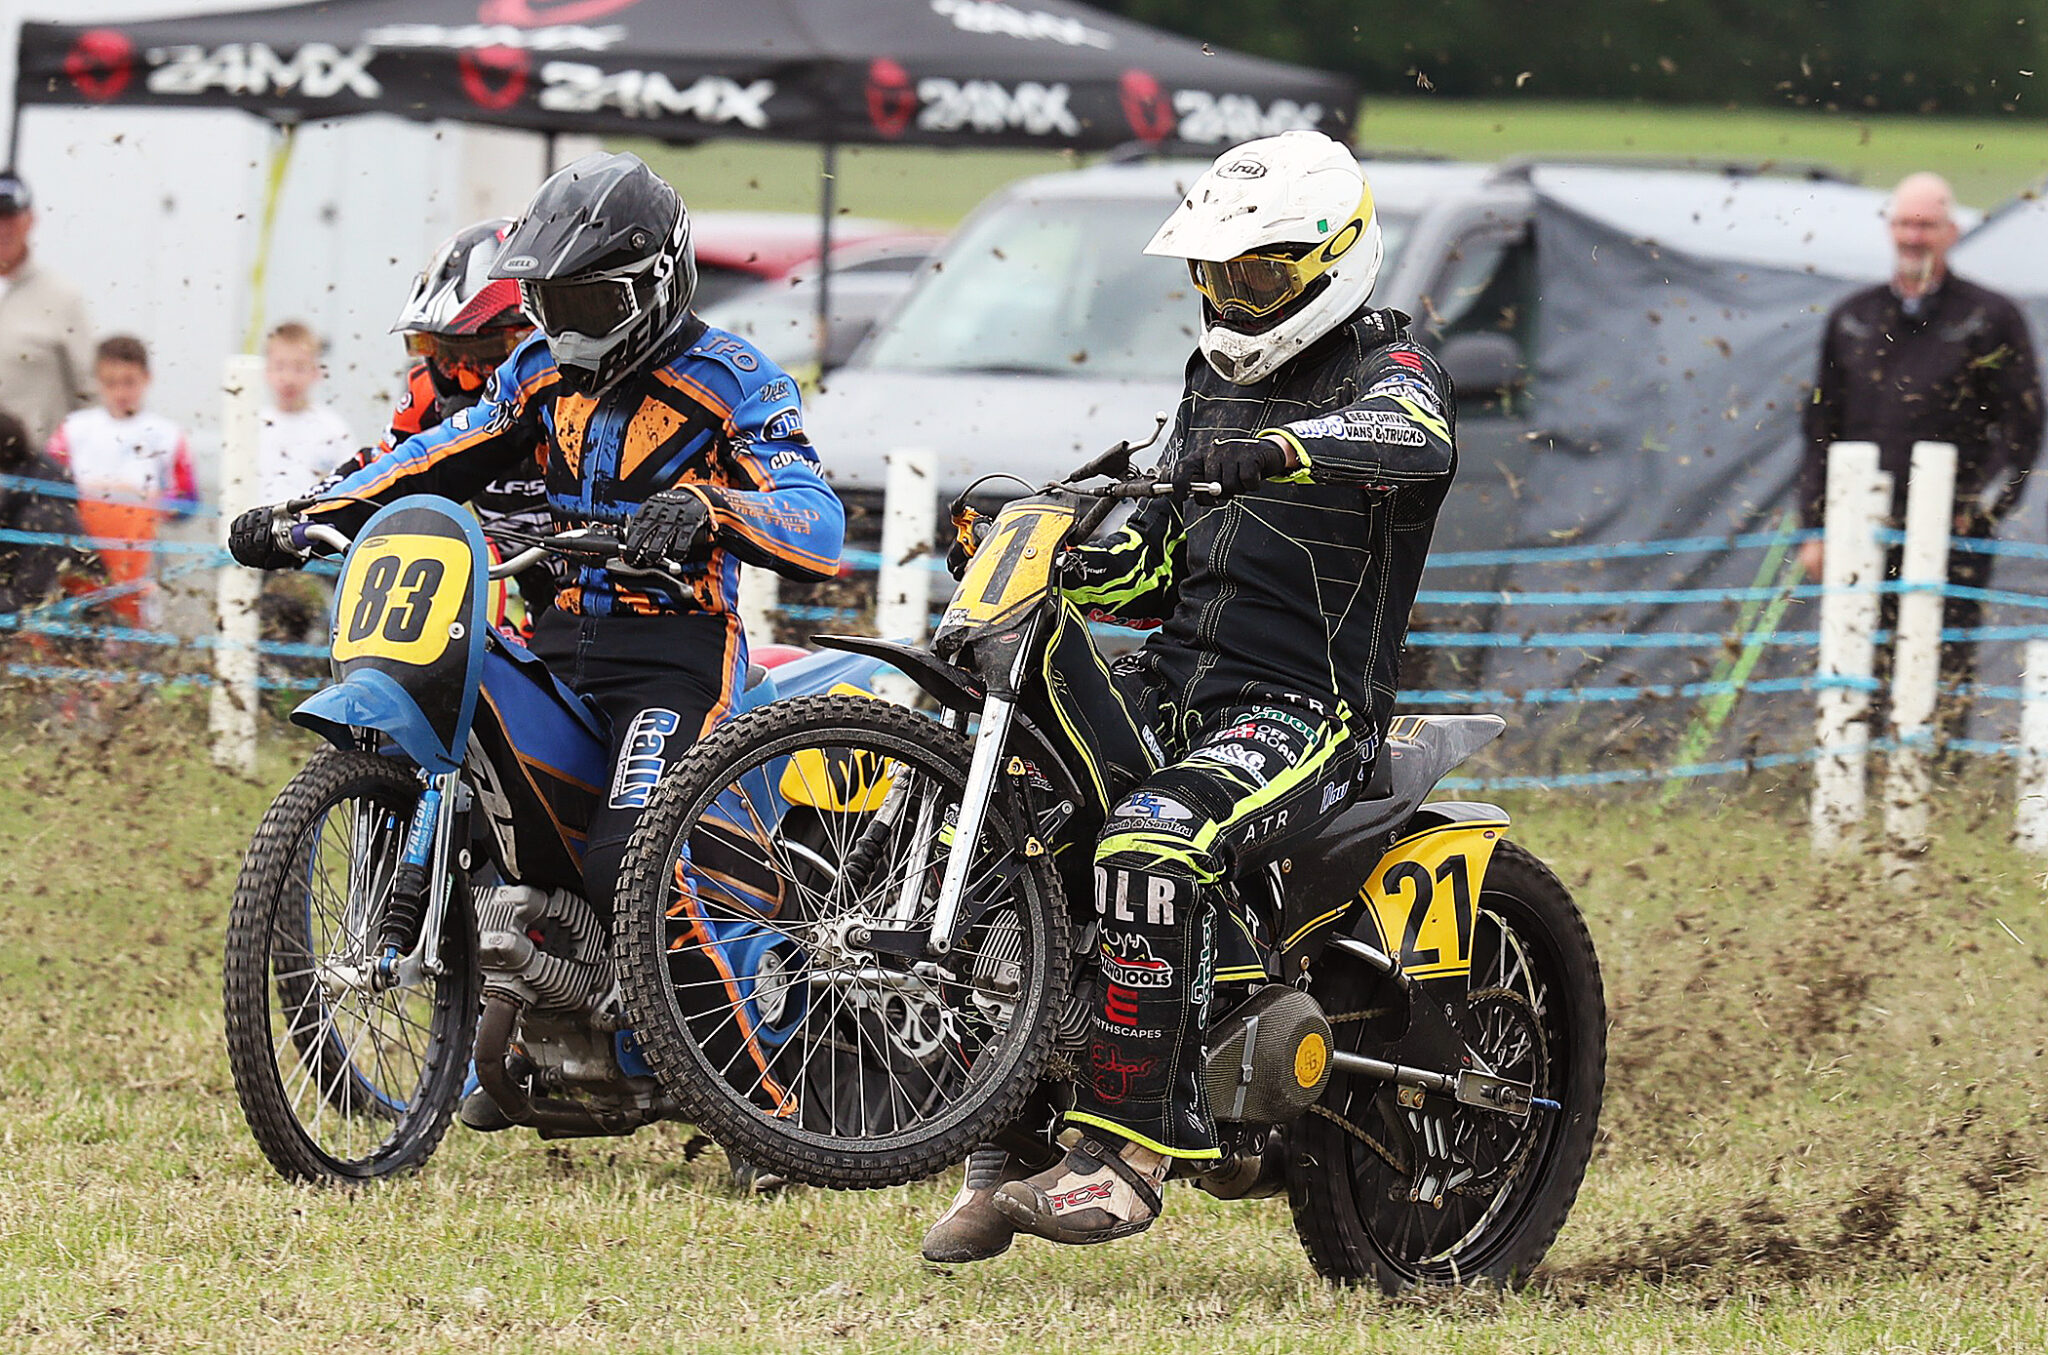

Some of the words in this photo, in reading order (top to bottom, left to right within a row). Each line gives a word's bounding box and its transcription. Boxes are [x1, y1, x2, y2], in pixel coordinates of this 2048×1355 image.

[146, 43, 382, 98] 24MX
[540, 61, 775, 129] 24MX
[916, 77, 1082, 137] 24MX
[1345, 426, 1373, 439] VANS
[1375, 426, 1382, 439] &
[1384, 428, 1424, 443] TRUCKS
[1349, 412, 1374, 421] SELF
[348, 555, 445, 642] 83
[610, 710, 678, 807] Rally
[1254, 732, 1298, 766] ROAD
[1257, 724, 1290, 741] OFF
[407, 799, 428, 856] FALCON
[1242, 809, 1289, 844] ATR
[1382, 853, 1473, 967] 21
